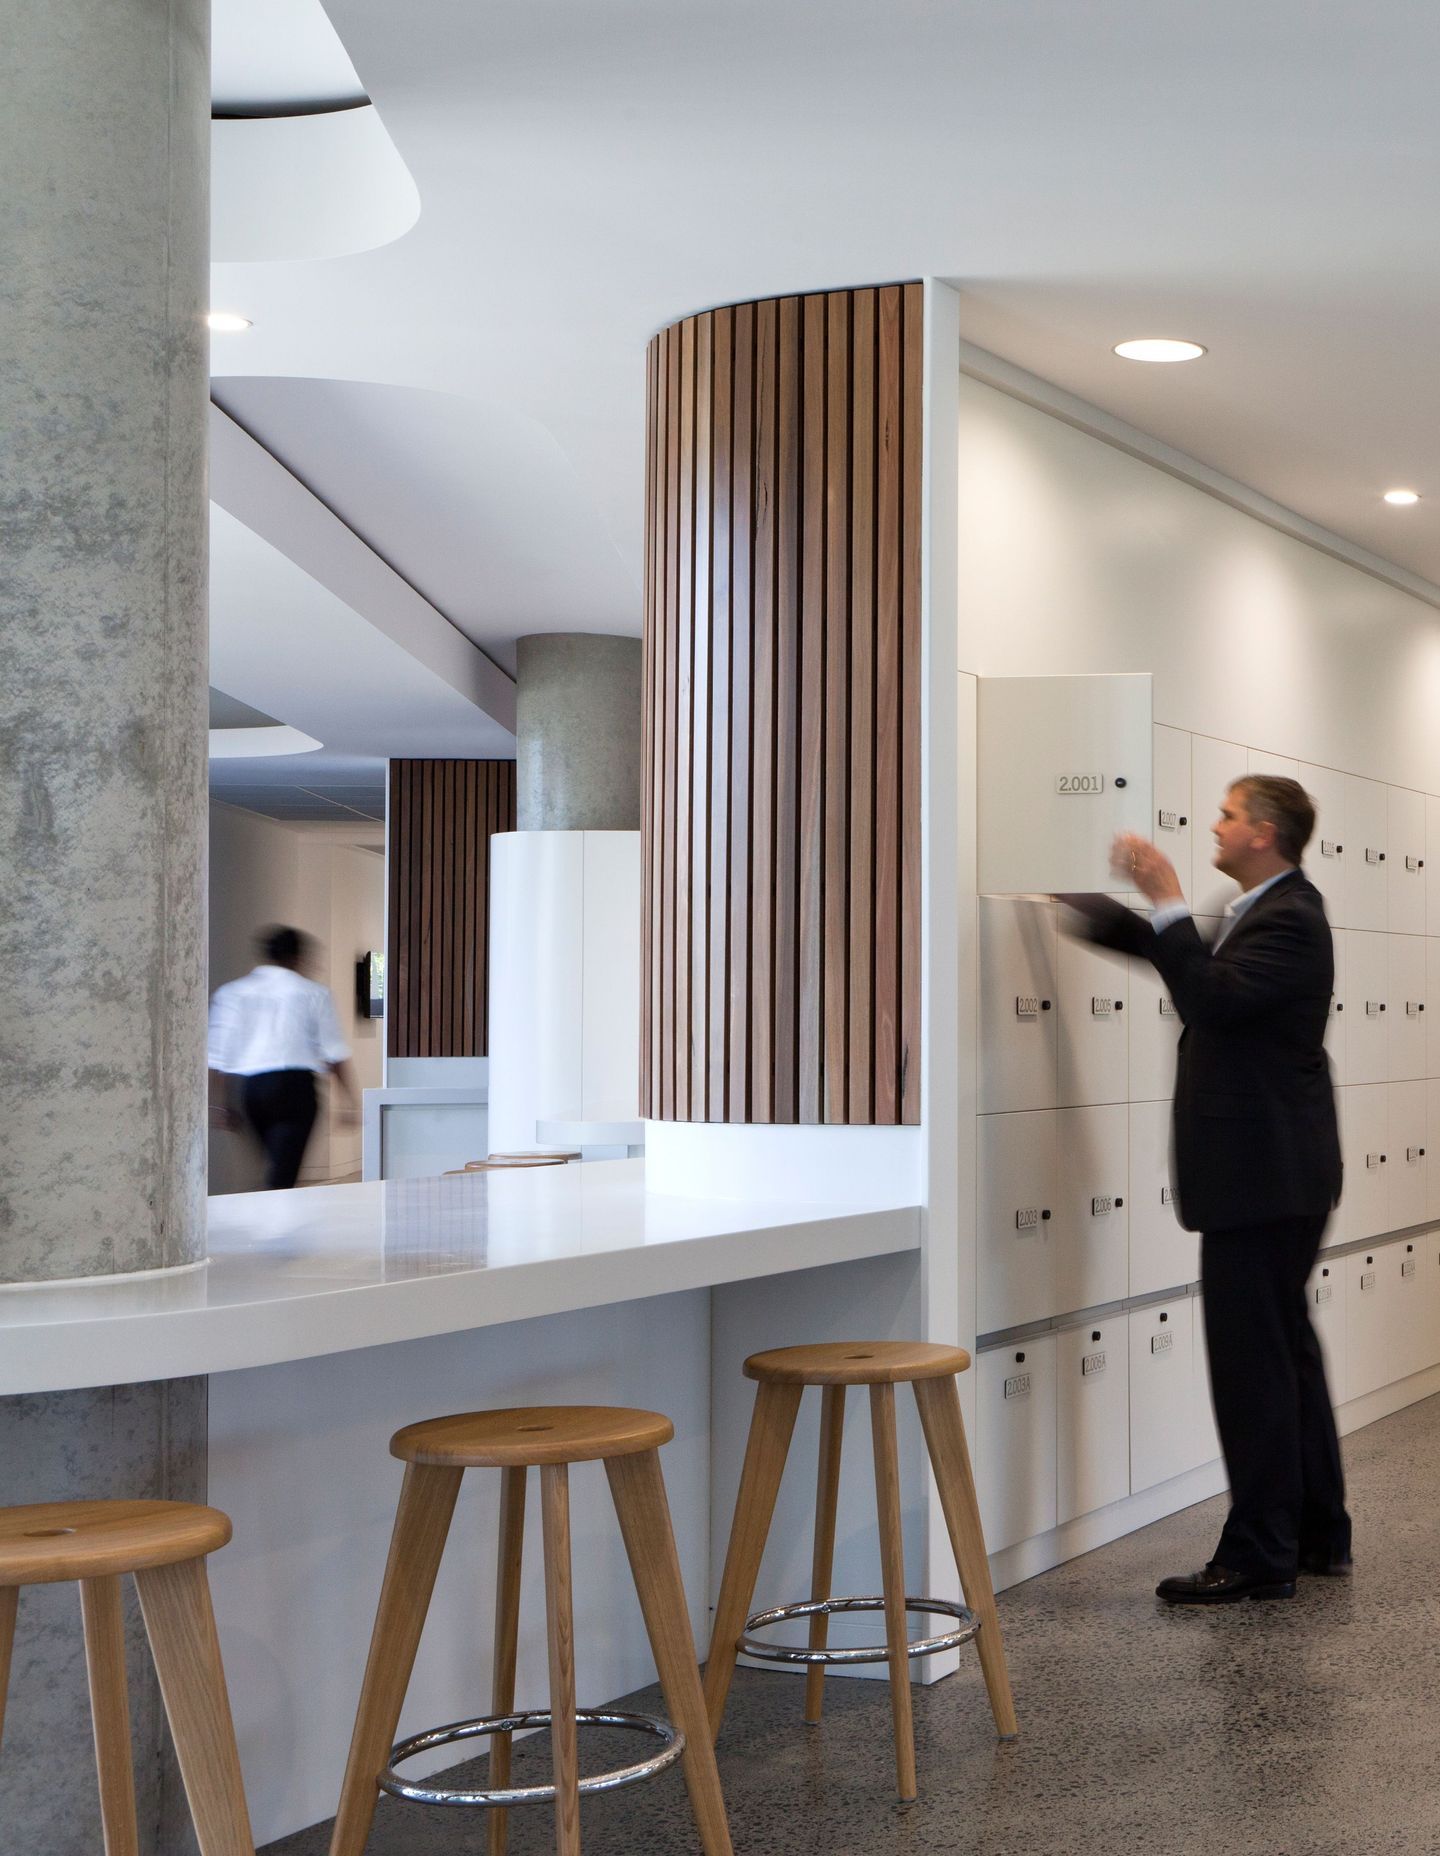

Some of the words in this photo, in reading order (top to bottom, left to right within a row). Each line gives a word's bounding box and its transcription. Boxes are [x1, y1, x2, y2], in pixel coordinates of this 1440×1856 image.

[1059, 776, 1098, 791] 2.001
[1019, 998, 1038, 1013] 2.002
[1019, 1209, 1038, 1226] 2.003
[1007, 1375, 1031, 1396] 2.003A
